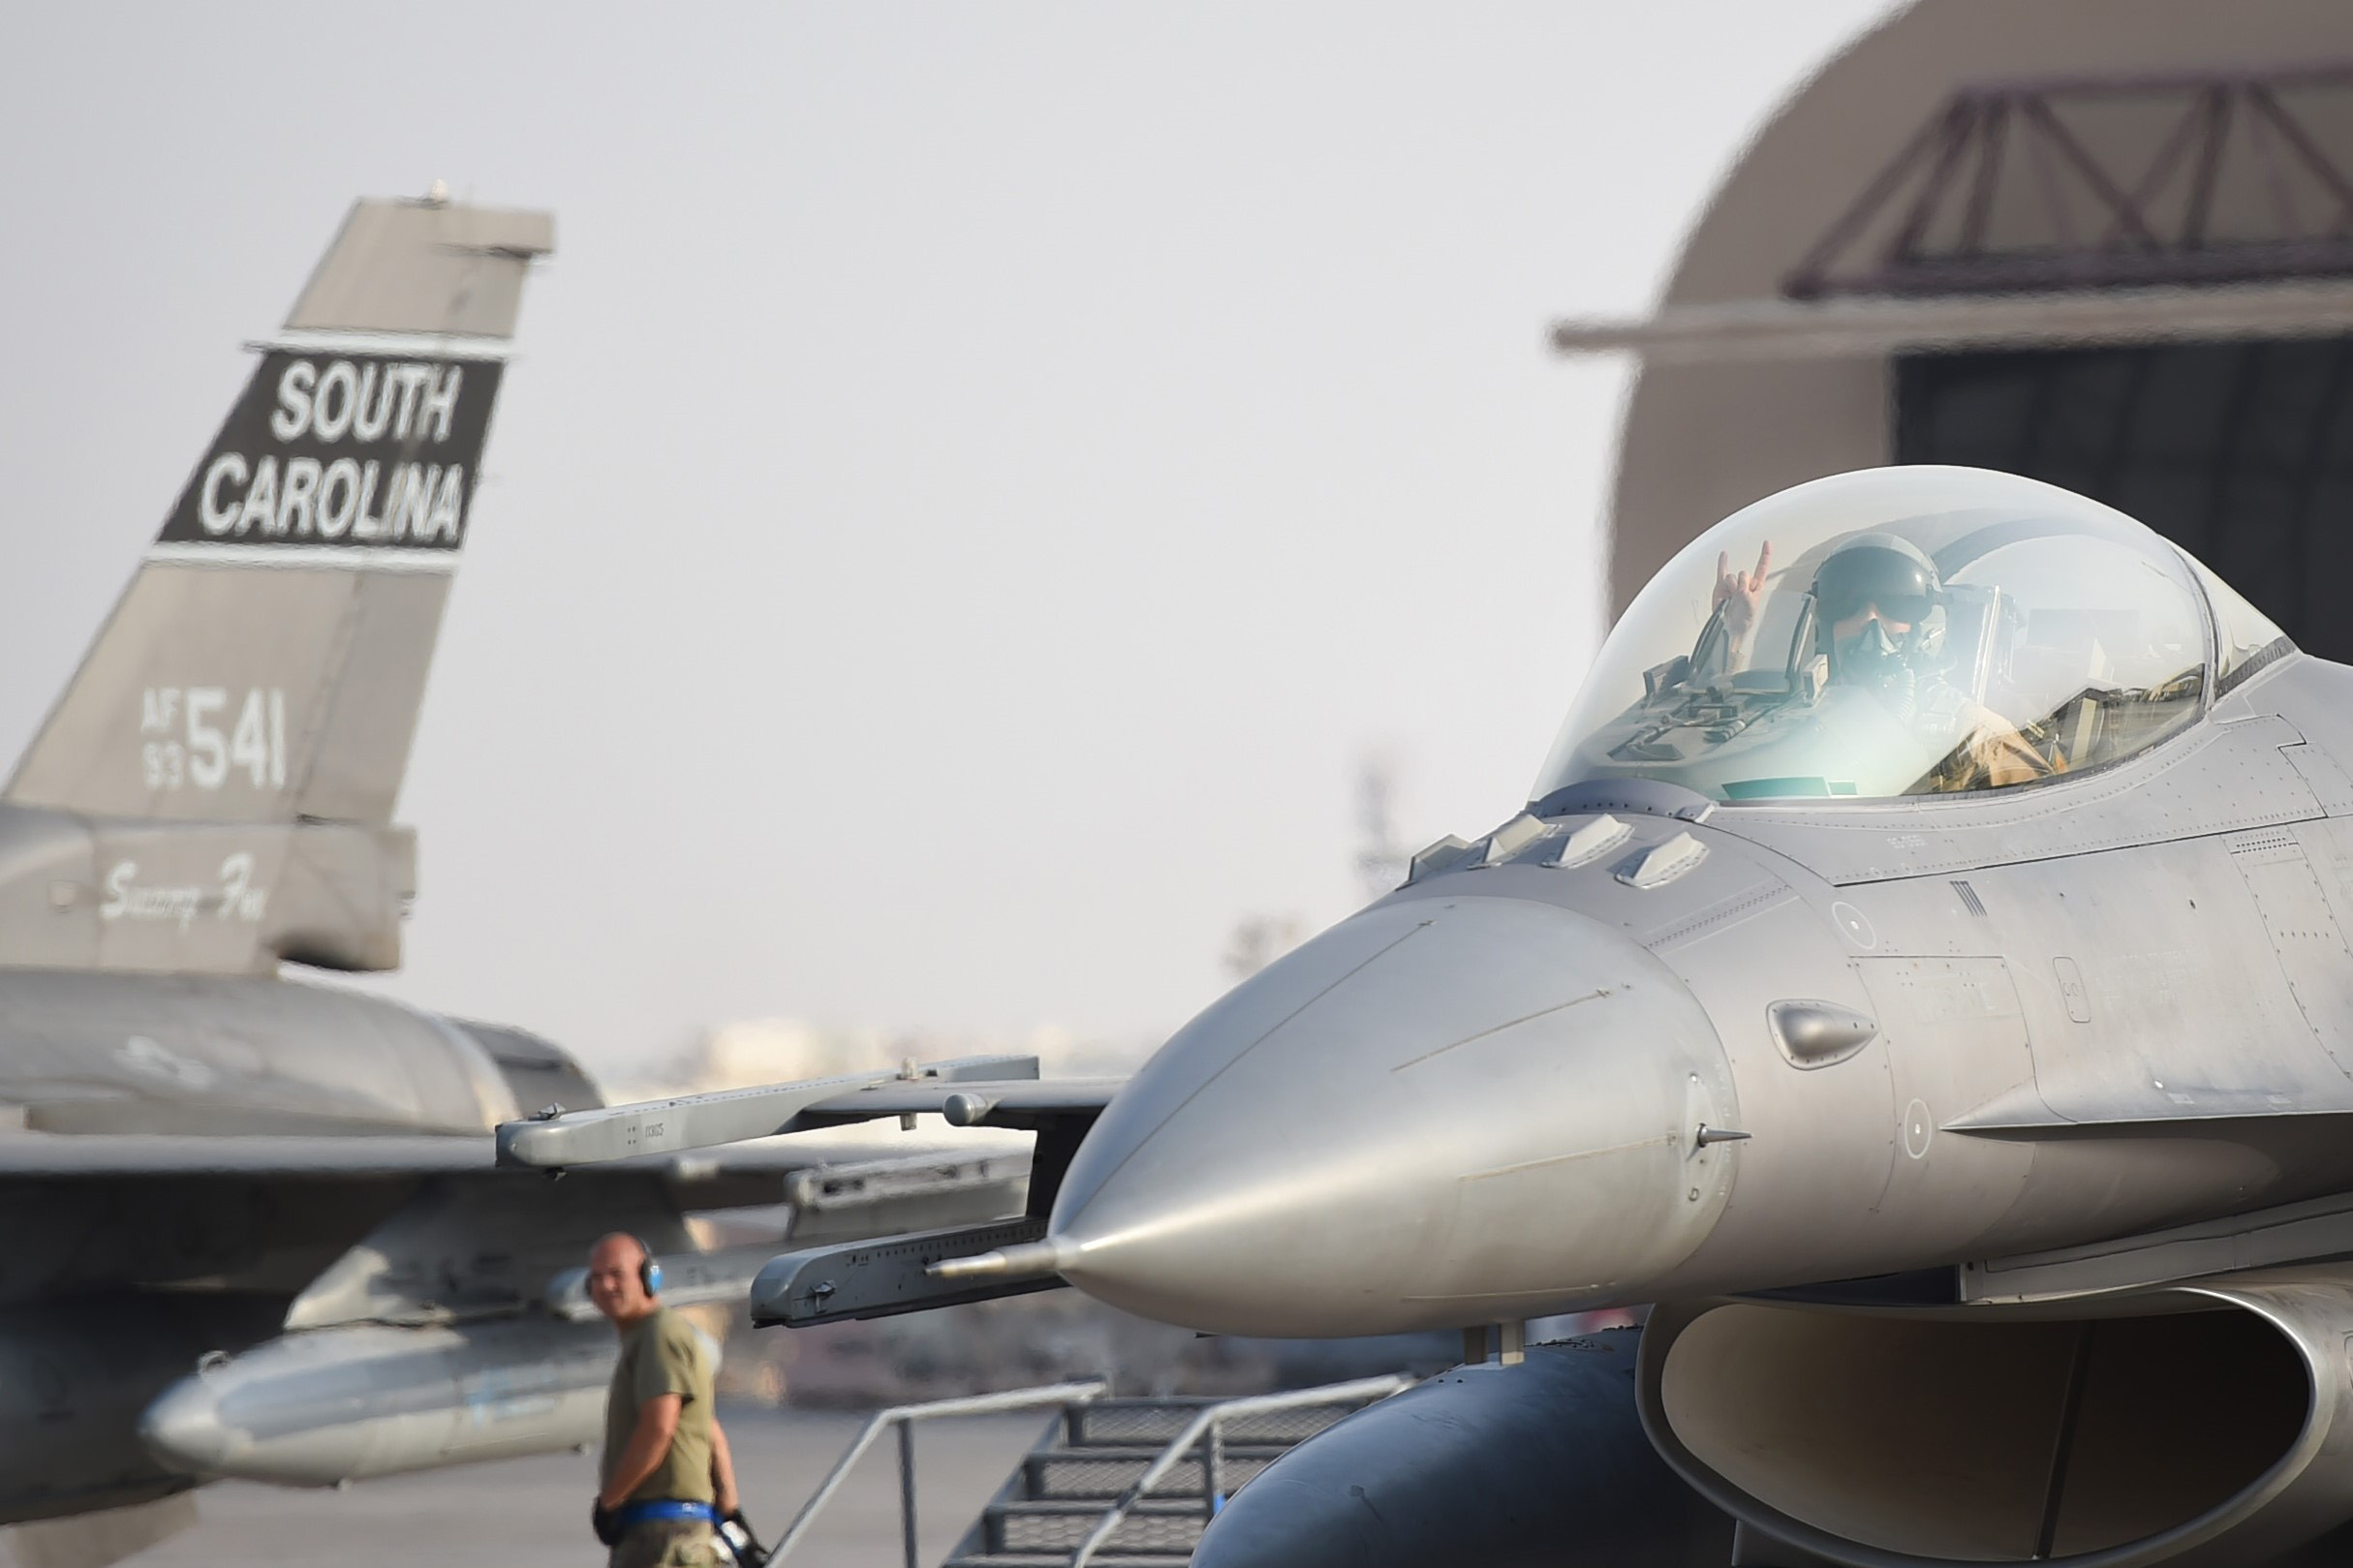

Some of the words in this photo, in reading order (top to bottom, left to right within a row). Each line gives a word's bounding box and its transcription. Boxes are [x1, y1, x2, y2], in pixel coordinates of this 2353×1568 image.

[271, 360, 462, 443] SOUTH
[199, 451, 463, 544] CAROLINA
[140, 688, 180, 732] AF
[186, 686, 287, 790] 541
